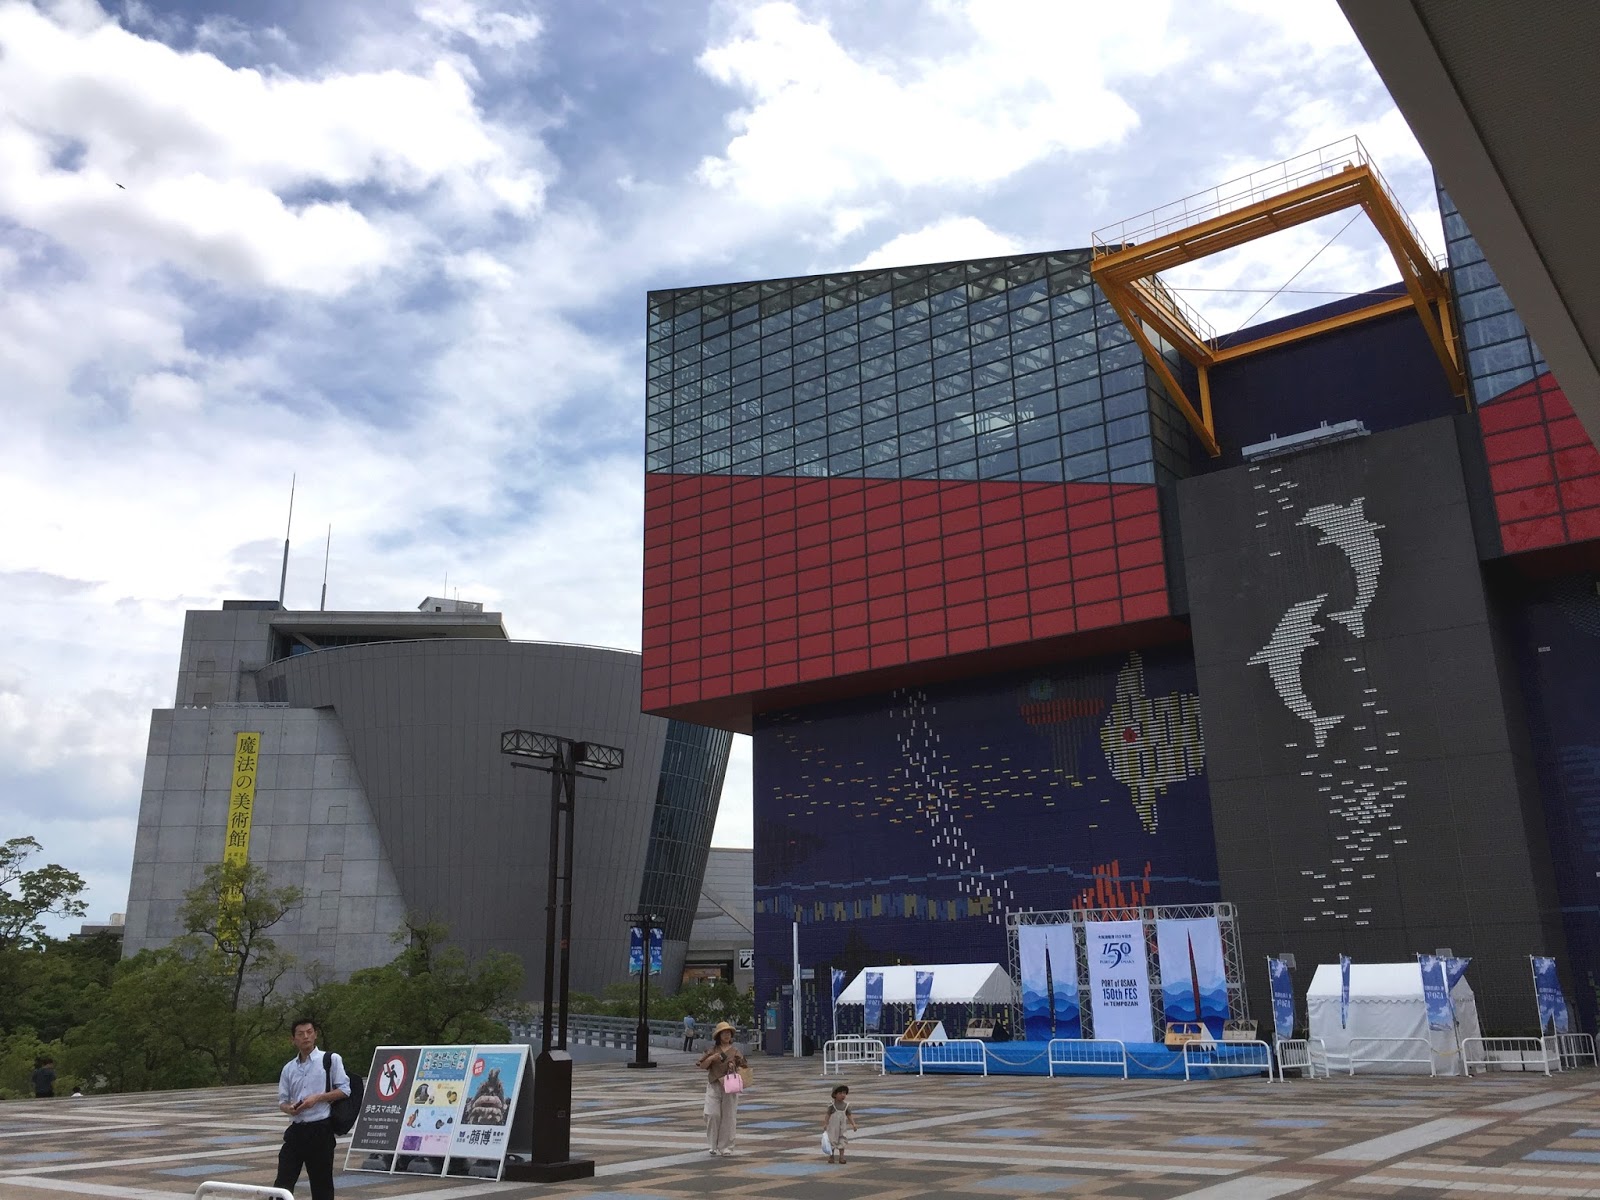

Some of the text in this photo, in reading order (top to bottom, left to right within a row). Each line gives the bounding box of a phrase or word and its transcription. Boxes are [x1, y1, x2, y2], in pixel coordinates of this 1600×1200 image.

[228, 736, 257, 848] 魔法の美術館
[1102, 942, 1131, 969] 150
[1101, 979, 1137, 987] PORT of OSAKA
[1103, 988, 1137, 1000] 150th FES
[365, 1104, 402, 1114] 歩きスマホ禁止
